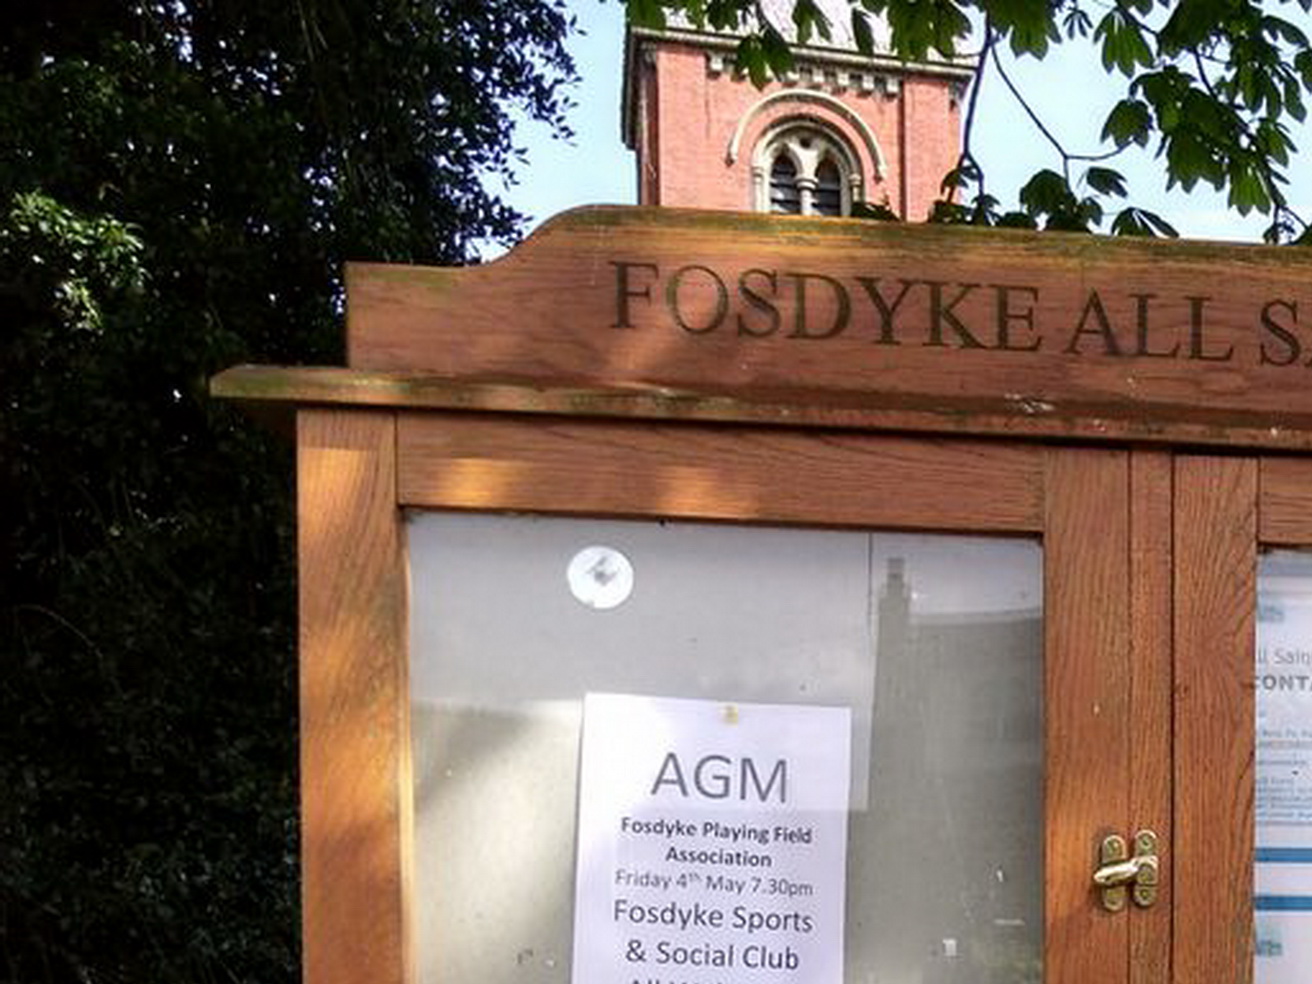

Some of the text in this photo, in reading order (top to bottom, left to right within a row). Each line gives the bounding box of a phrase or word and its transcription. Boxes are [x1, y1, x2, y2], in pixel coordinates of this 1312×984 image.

[608, 259, 1043, 352] FOSDYKE
[1062, 286, 1235, 363] ALL
[650, 751, 788, 804] AGM
[620, 816, 813, 845] Fosdyke Playing Field
[665, 846, 773, 868] Association
[614, 868, 672, 892] Friday
[705, 875, 746, 895] May
[750, 876, 814, 898] 7.30pm
[613, 898, 814, 934] Fosdyke Sports
[625, 938, 800, 971] & Social Club
